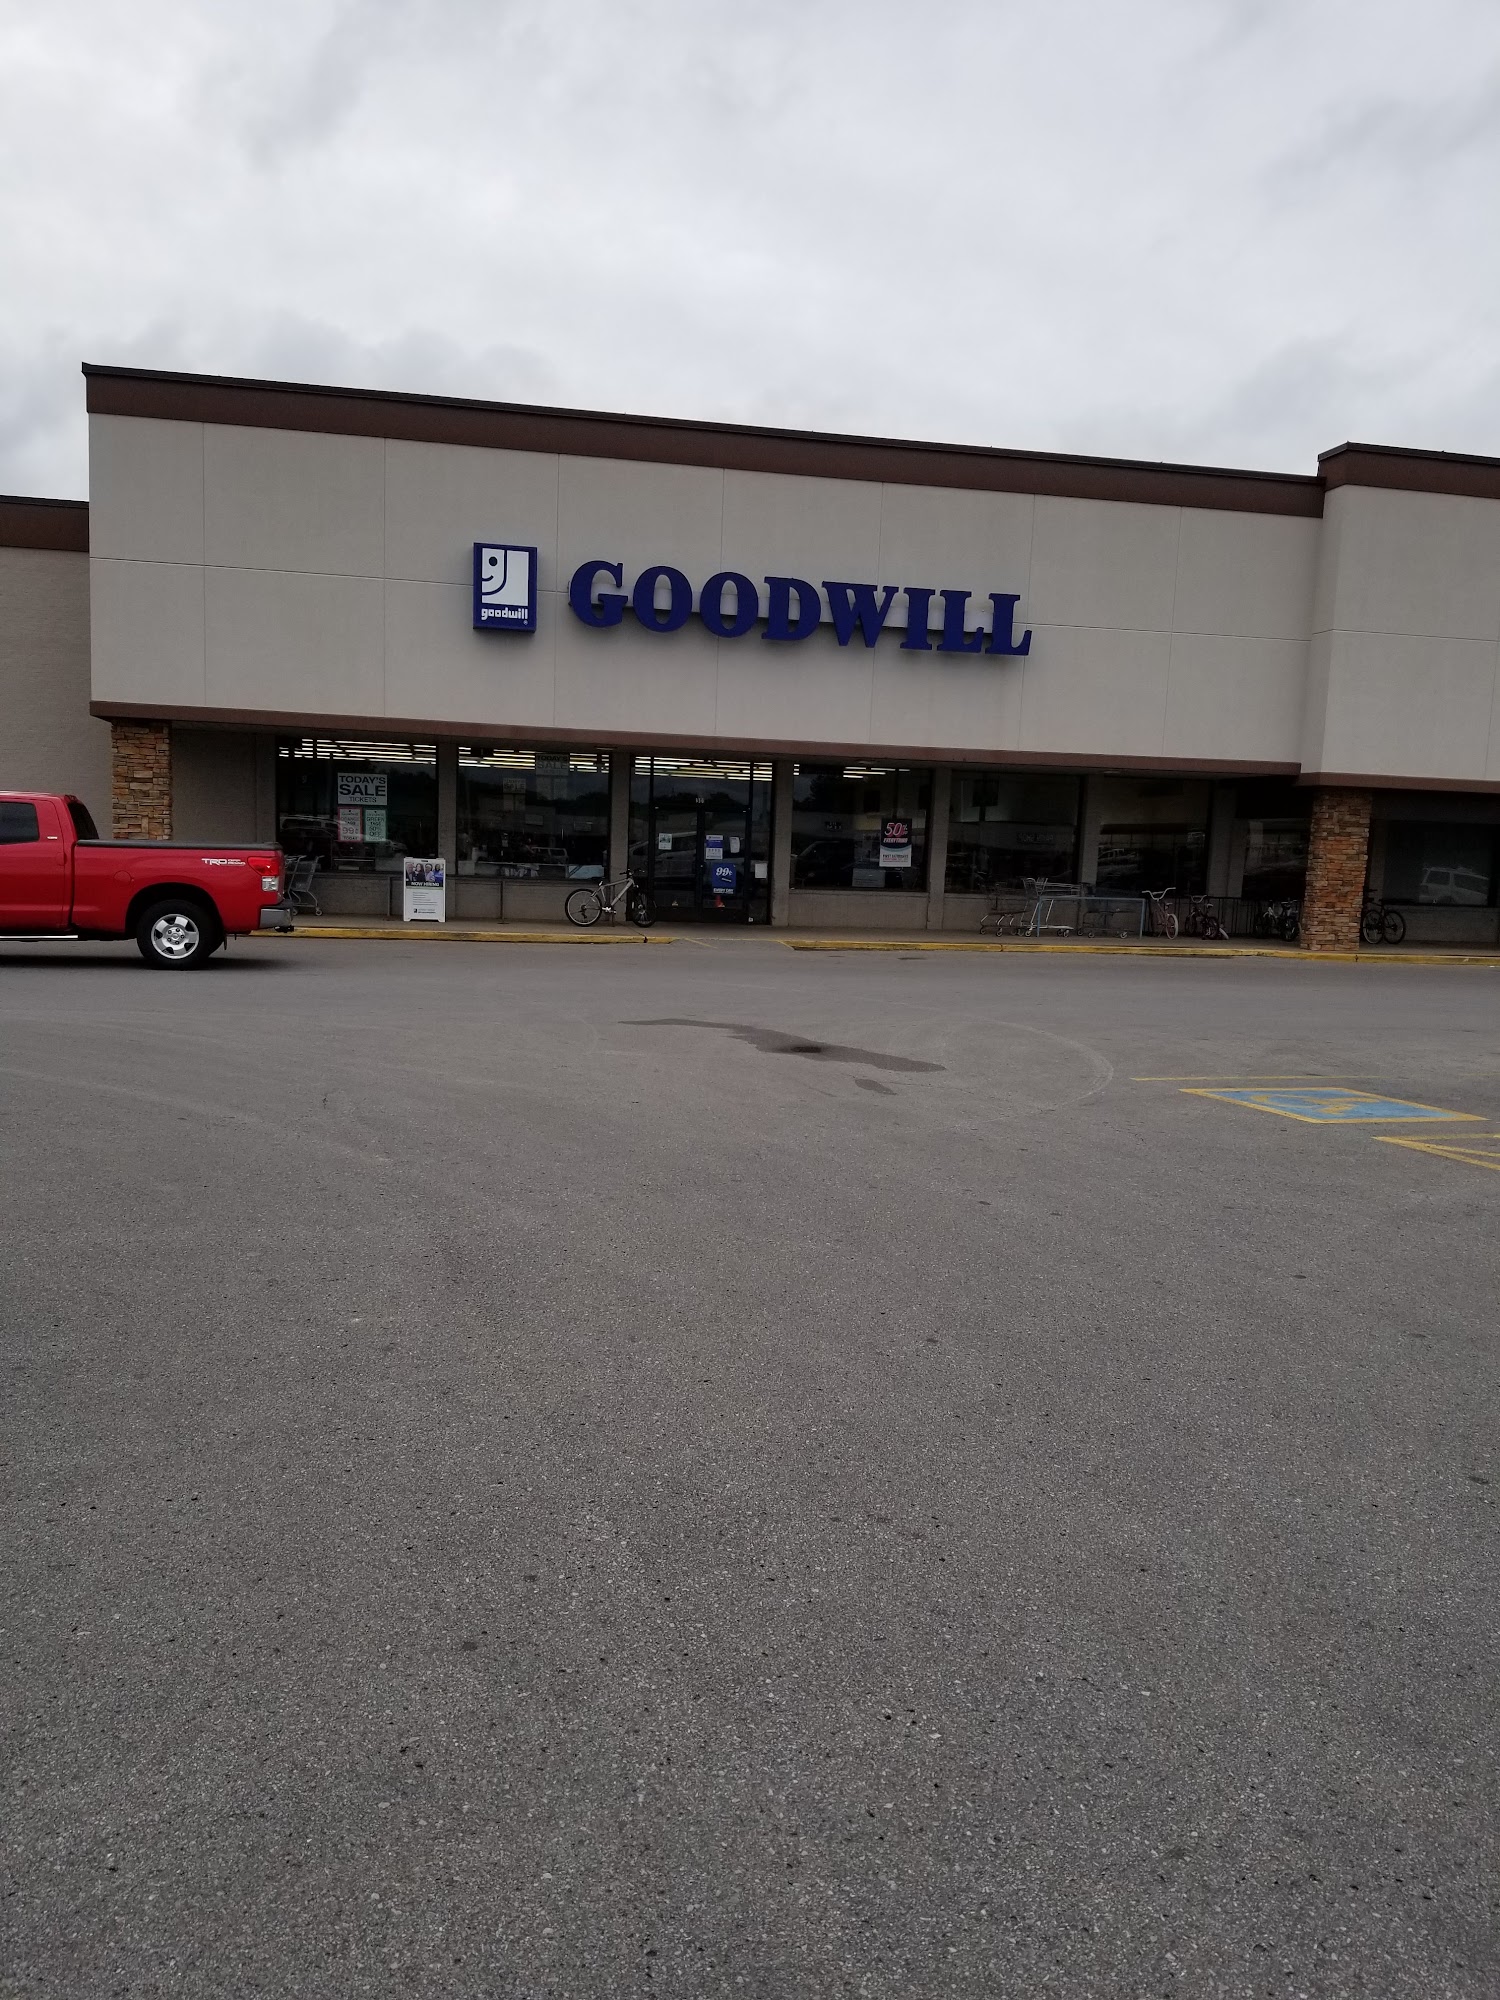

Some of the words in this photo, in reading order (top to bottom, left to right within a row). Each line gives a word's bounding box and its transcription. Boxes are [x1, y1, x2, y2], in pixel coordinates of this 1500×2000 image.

[569, 560, 1033, 656] GOODWILL
[481, 607, 528, 621] goodwill
[537, 761, 568, 769] SALE
[339, 775, 386, 785] TODAY'S
[339, 784, 387, 797] SALE
[201, 858, 227, 866] TRD
